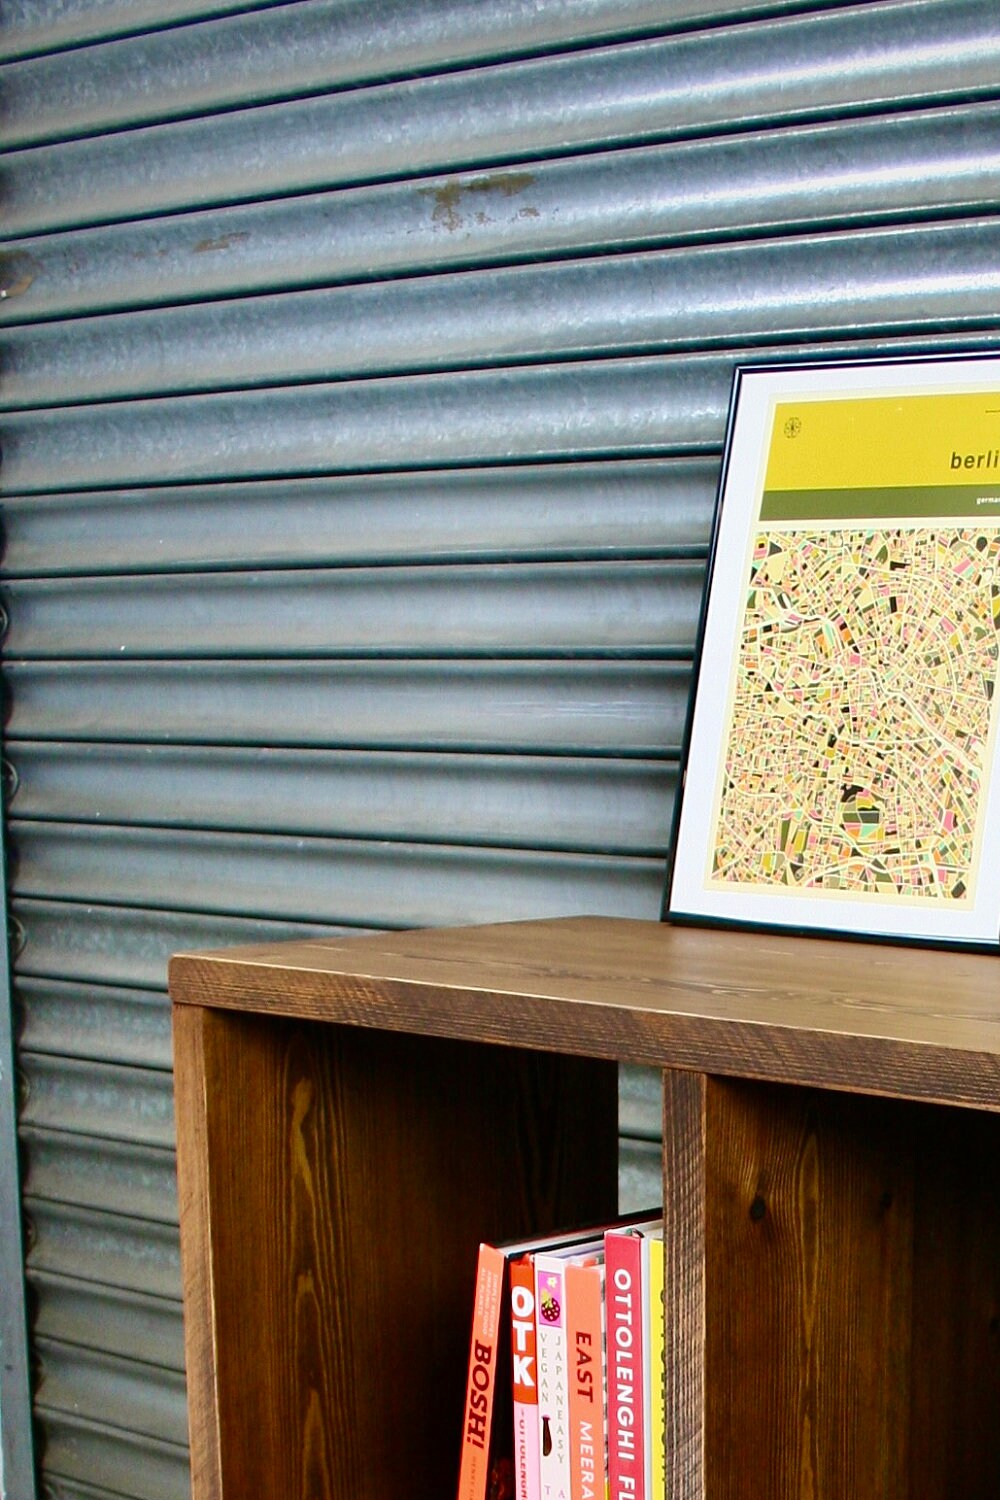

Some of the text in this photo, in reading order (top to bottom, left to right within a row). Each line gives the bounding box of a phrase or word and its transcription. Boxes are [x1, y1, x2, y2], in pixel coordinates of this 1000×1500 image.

[511, 1285, 535, 1388] OTK
[540, 1332, 549, 1403] VEGAN
[575, 1330, 594, 1404] EAST
[614, 1268, 635, 1461] OTTOLENGHI
[466, 1339, 493, 1450] BOSH!
[555, 1334, 566, 1465] JAPANEASY
[579, 1420, 595, 1500] MEERA
